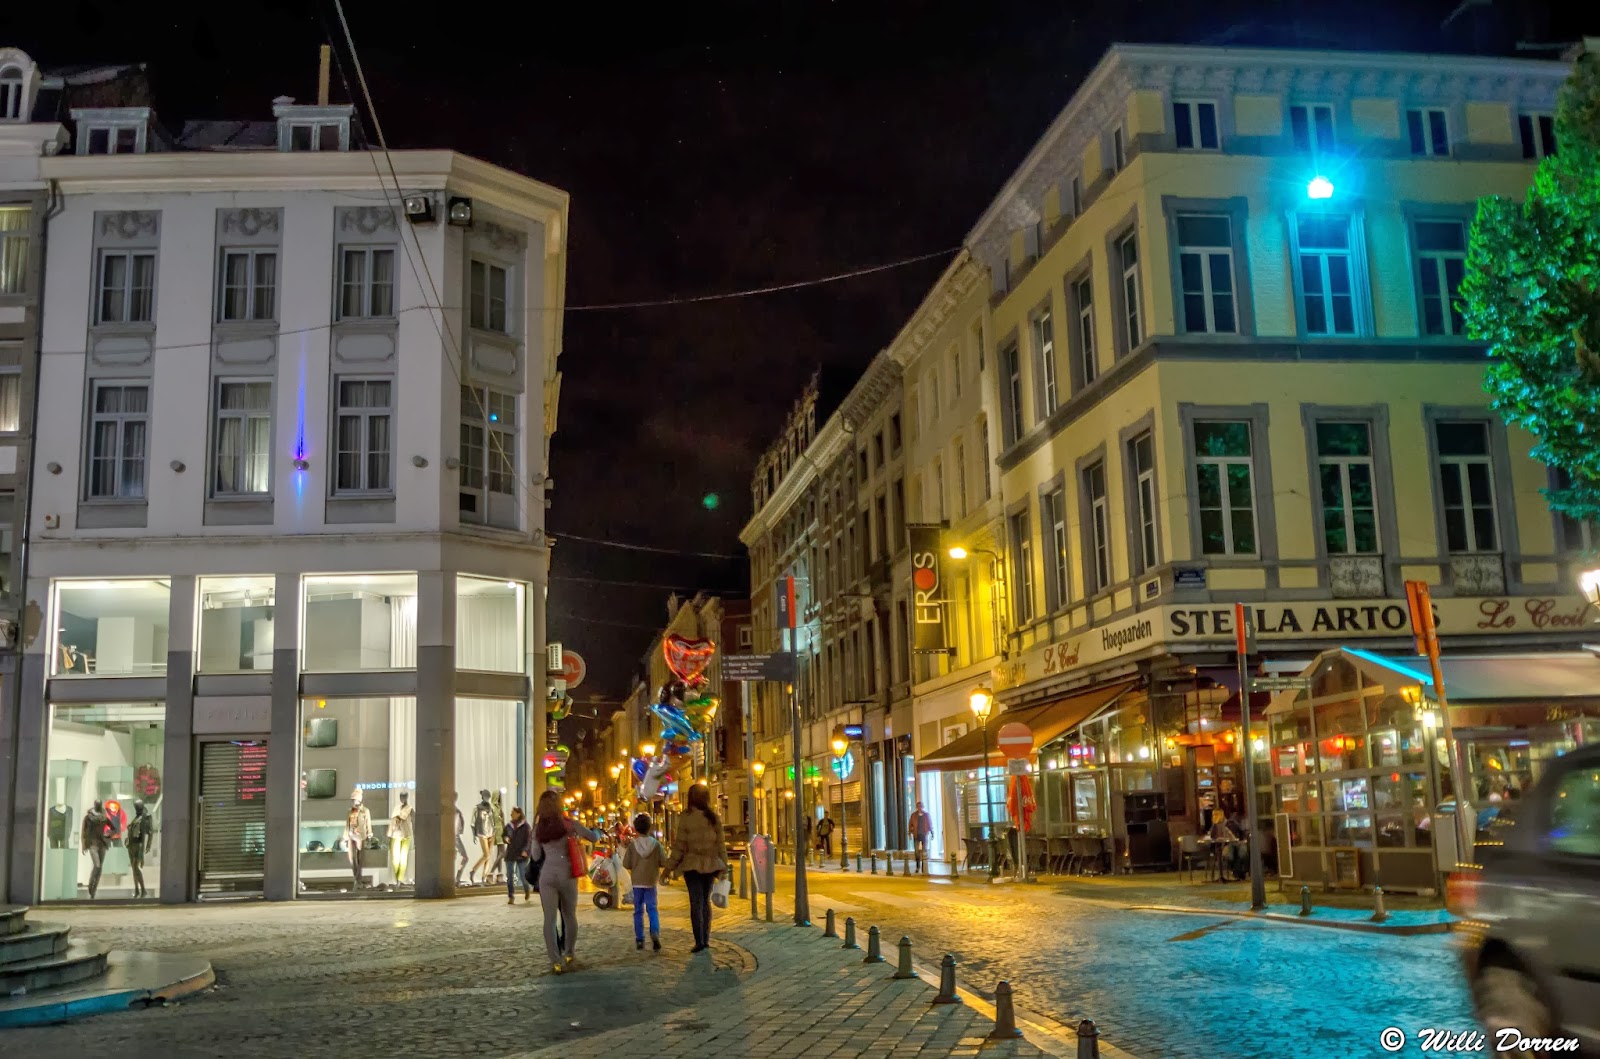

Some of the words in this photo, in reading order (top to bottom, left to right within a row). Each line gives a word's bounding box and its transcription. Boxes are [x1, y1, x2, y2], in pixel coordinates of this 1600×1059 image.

[1170, 607, 1304, 636] STELA
[1477, 599, 1516, 629] Le
[1524, 598, 1591, 630] Cecil
[1101, 618, 1152, 652] Hoegaarden
[1043, 647, 1056, 675] Le
